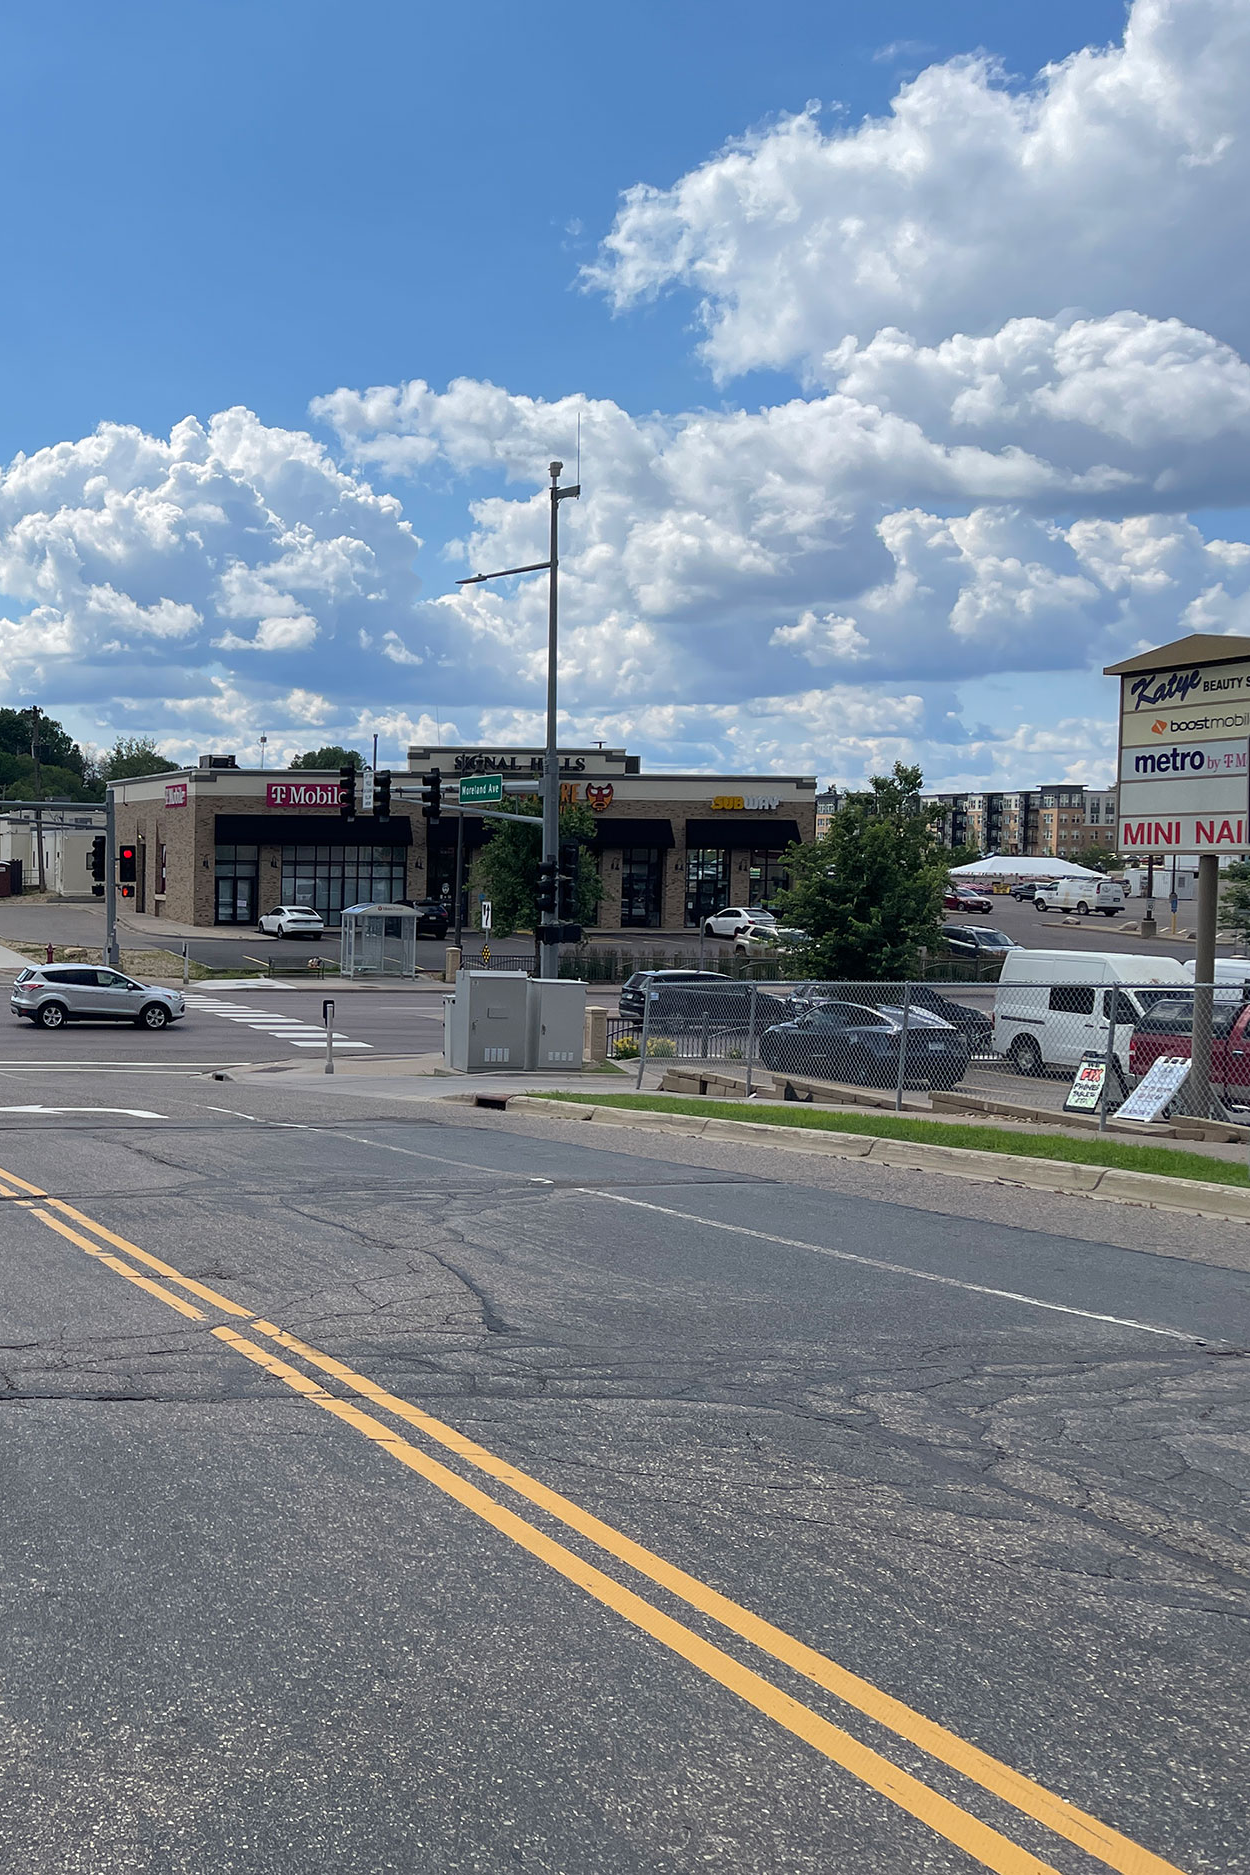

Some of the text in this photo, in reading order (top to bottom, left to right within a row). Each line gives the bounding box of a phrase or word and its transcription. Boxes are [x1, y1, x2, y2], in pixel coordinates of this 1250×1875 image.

[1131, 670, 1202, 711] Katye
[1203, 677, 1244, 692] BEAUTY
[1170, 712, 1250, 732] boostmobil
[454, 755, 586, 771] SIGNAL HLS
[1135, 747, 1205, 773] metro
[1207, 756, 1221, 773] by
[461, 783, 499, 796] Moreland Ave
[710, 796, 781, 810] SUBWAY
[1124, 820, 1248, 846] MINI NAI
[1080, 1068, 1105, 1082] FIX
